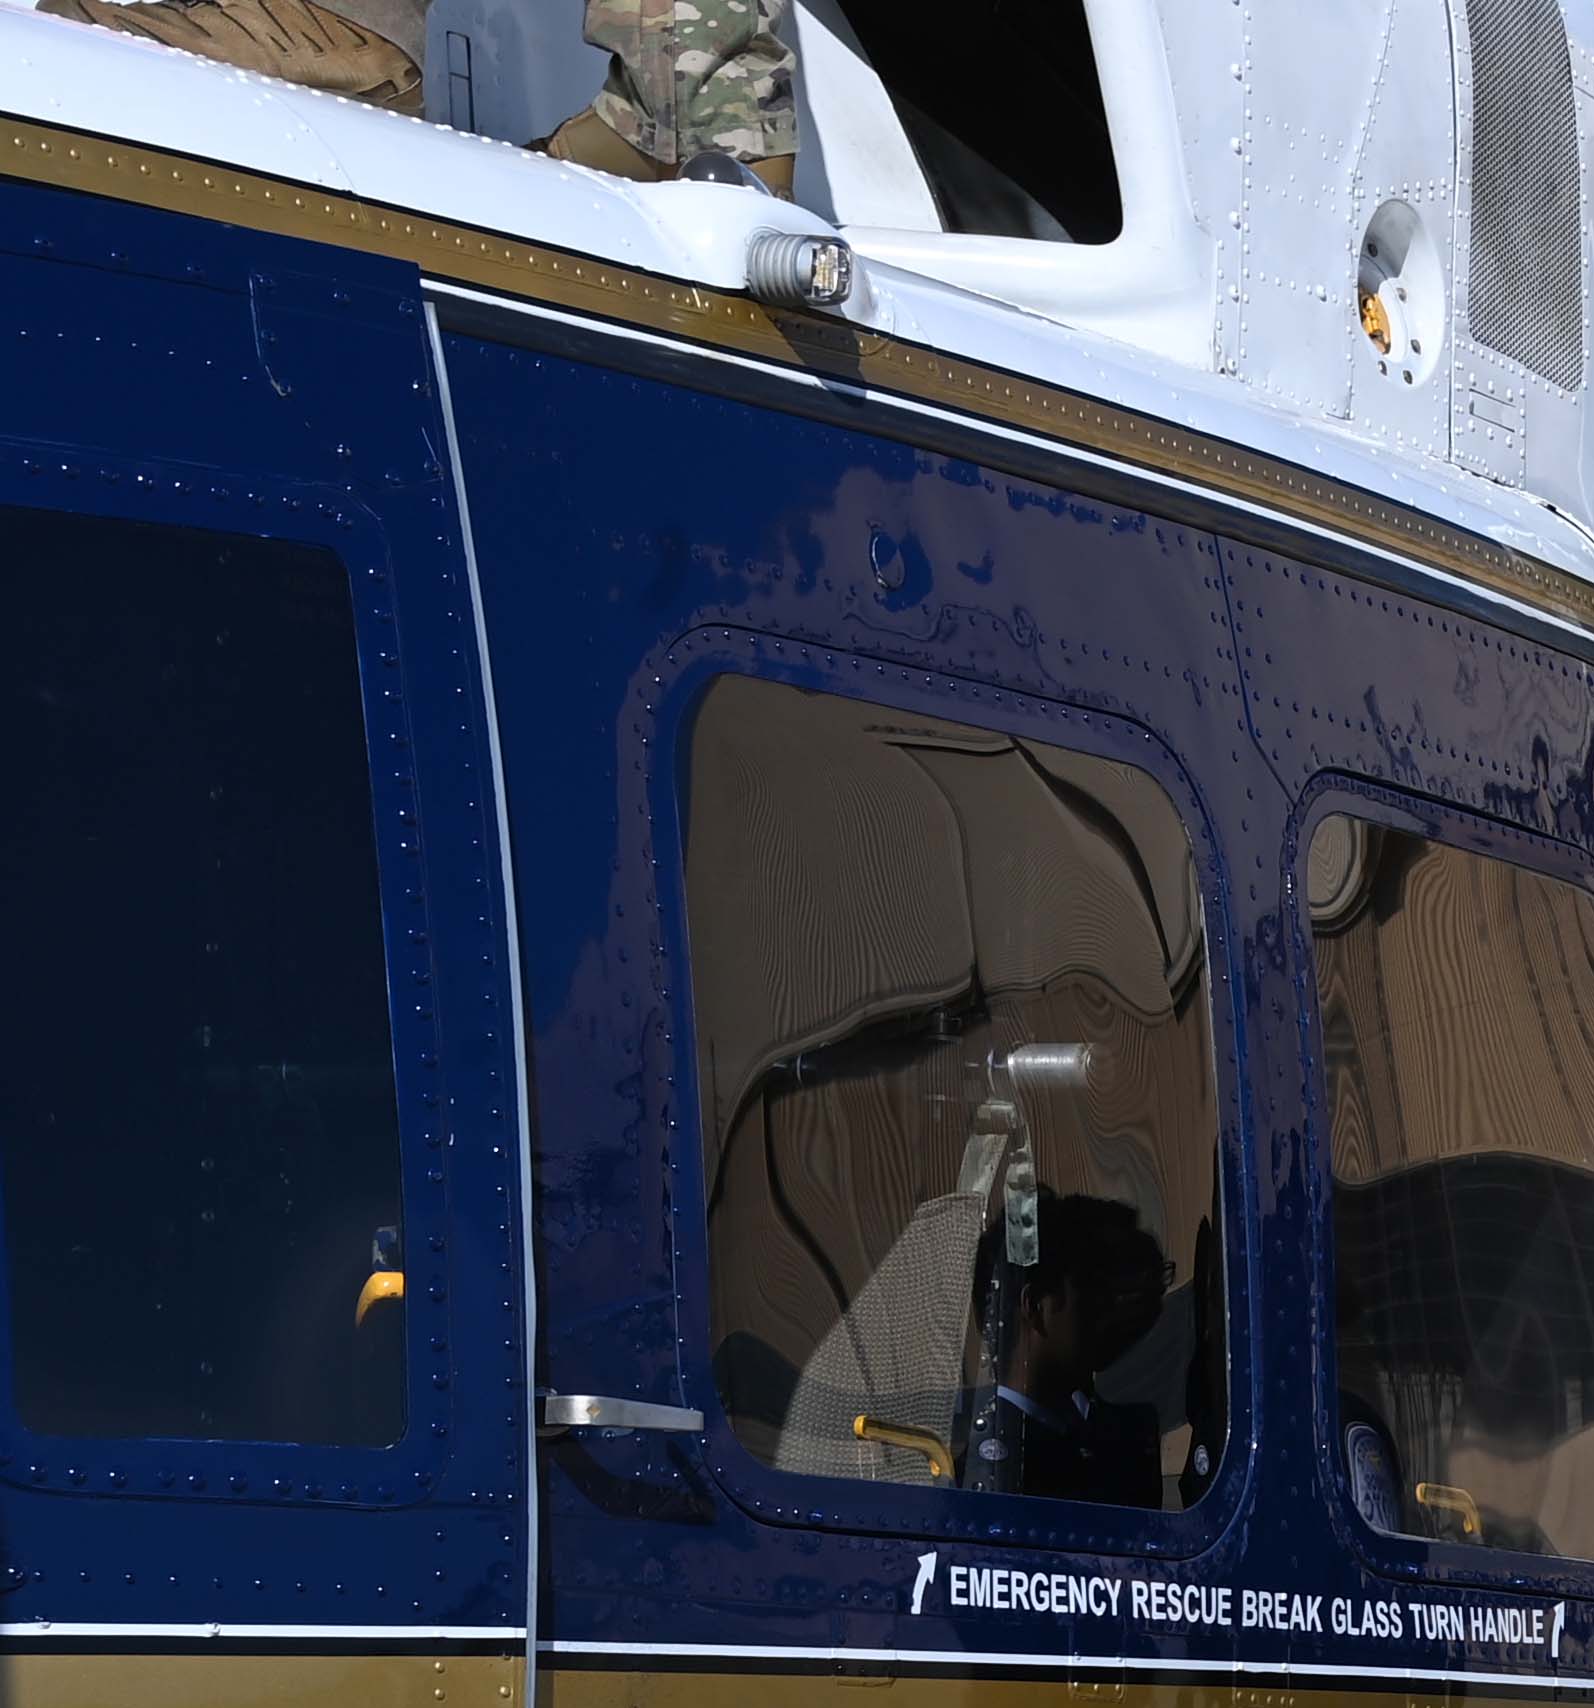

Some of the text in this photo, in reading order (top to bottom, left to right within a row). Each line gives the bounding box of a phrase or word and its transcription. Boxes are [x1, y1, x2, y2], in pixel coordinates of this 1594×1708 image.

[950, 1565, 1545, 1645] EMERGENCY RESCUE BREAK GLASS TURN HANDLE
